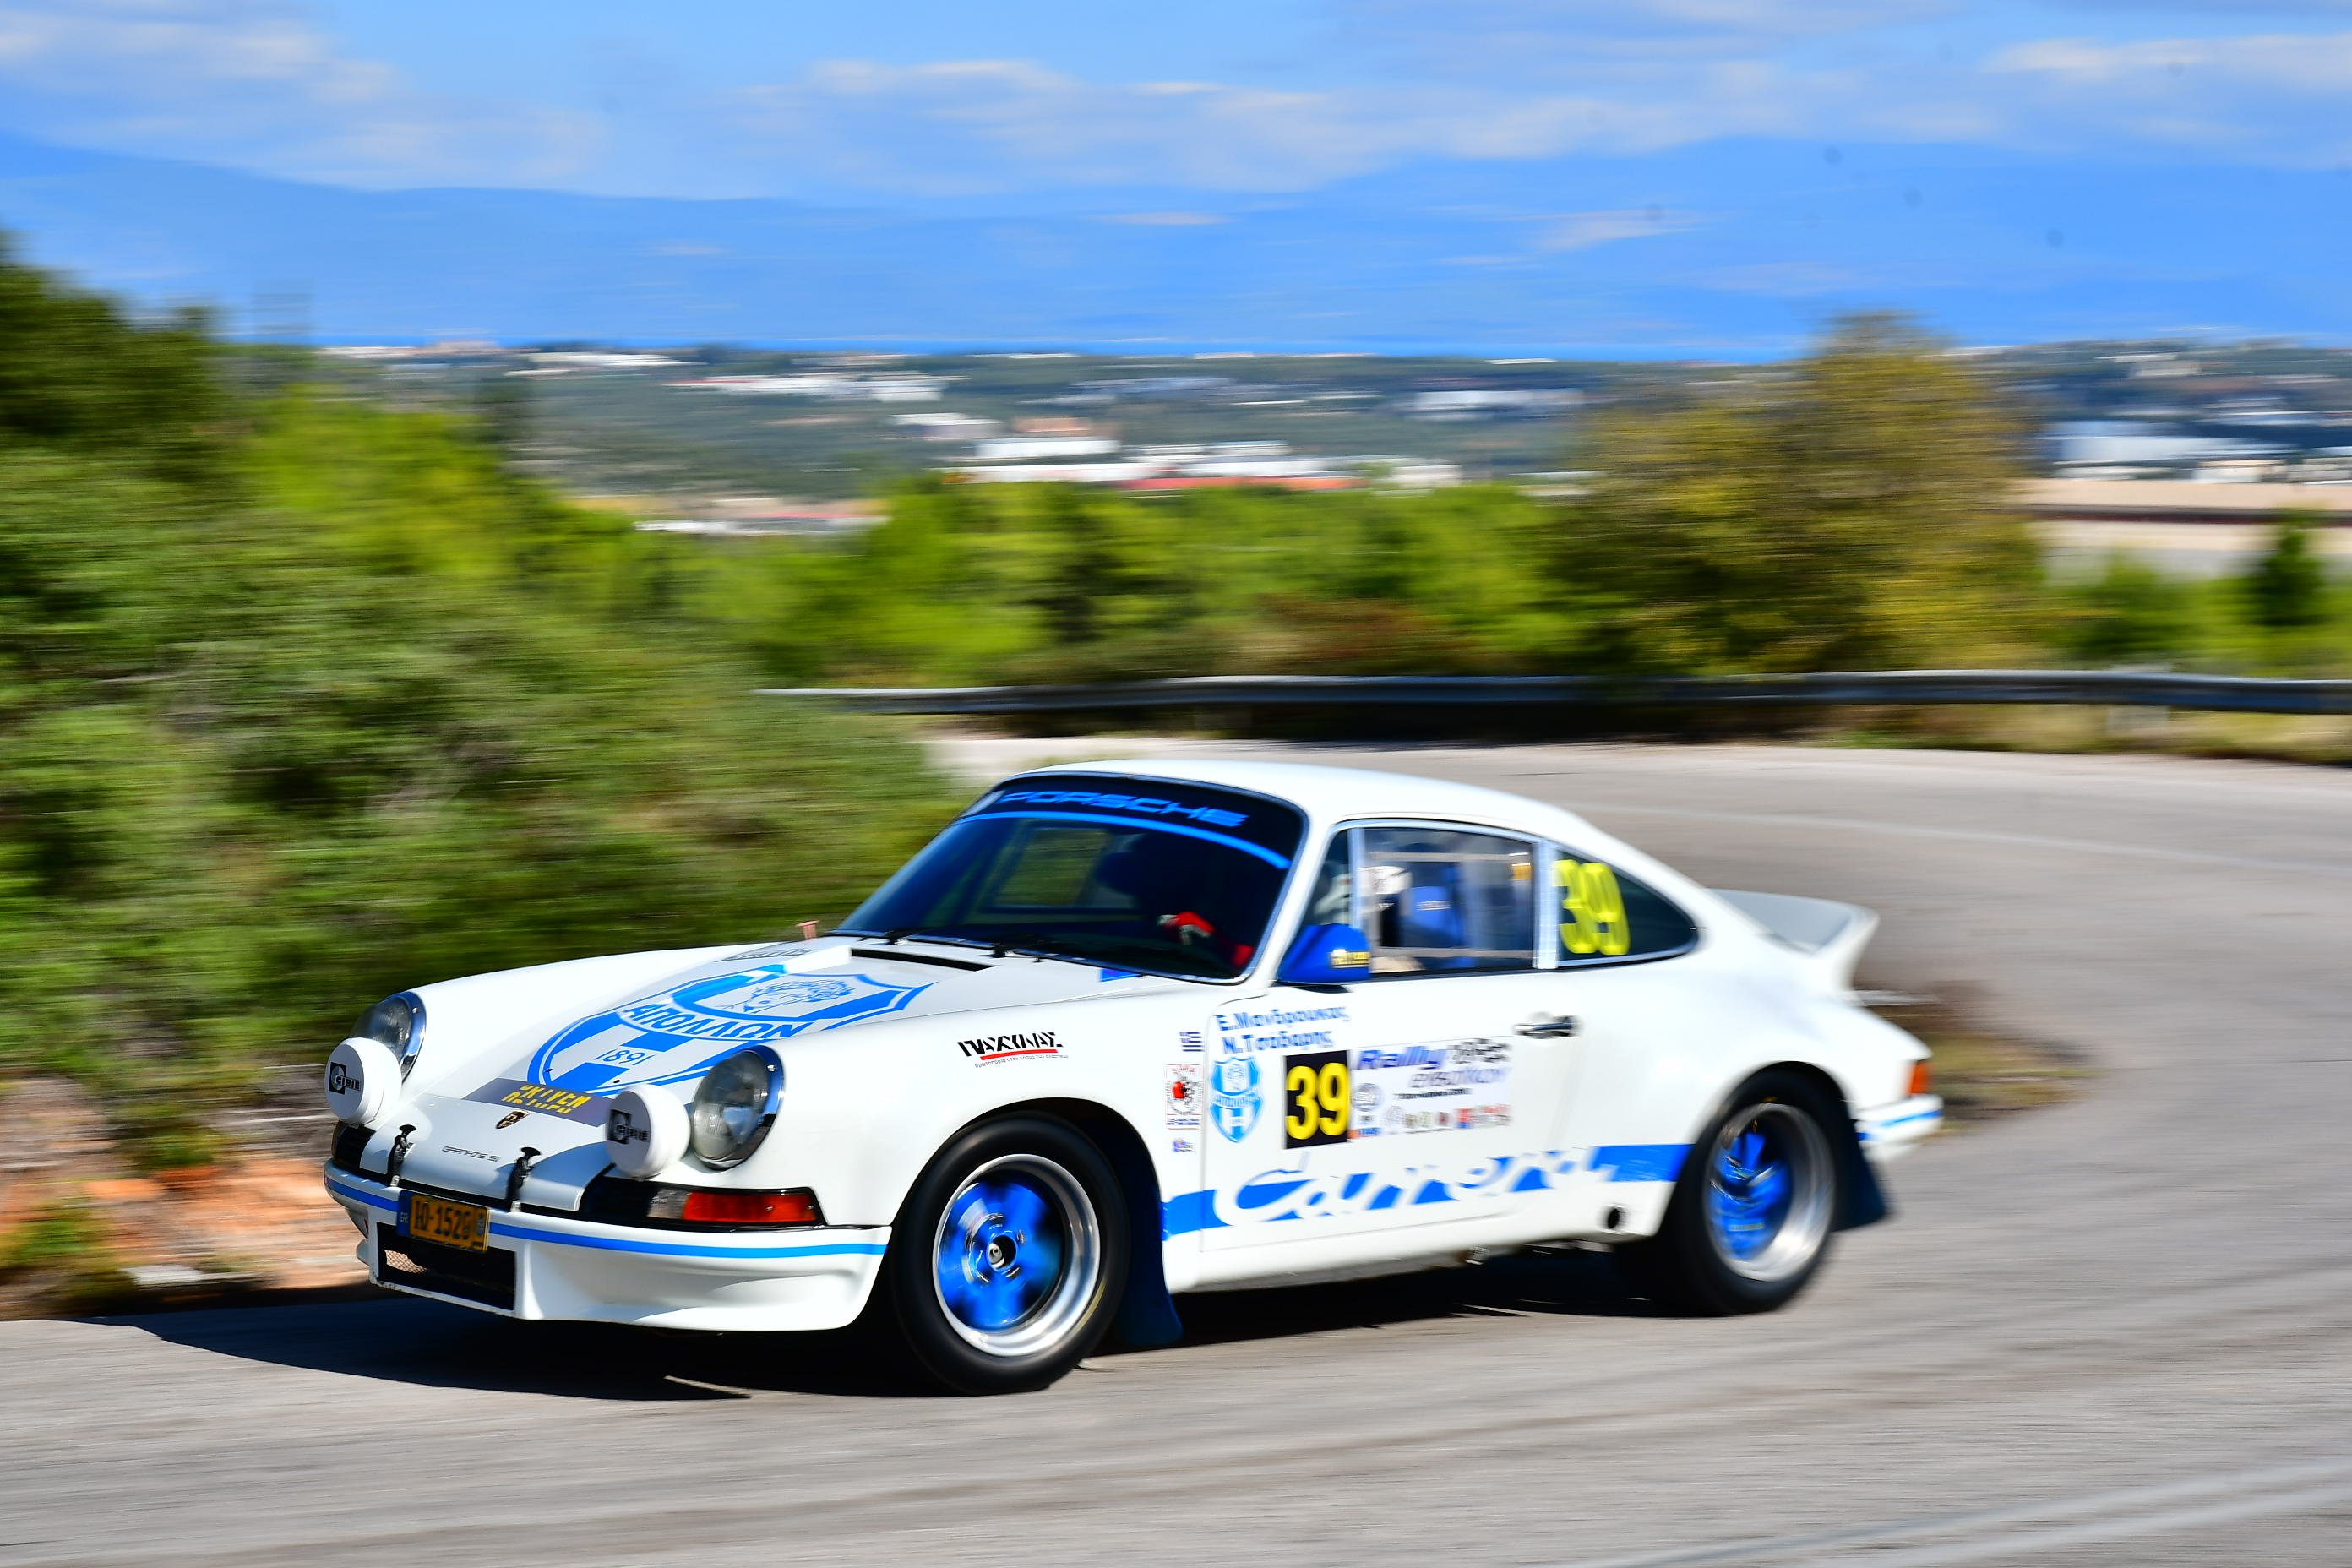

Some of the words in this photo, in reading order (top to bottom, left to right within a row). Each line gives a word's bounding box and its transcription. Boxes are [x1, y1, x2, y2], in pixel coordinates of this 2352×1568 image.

[994, 791, 1250, 827] PORSCHE
[1553, 859, 1630, 955] 39
[594, 1048, 655, 1066] 1891
[1285, 1062, 1350, 1140] 39
